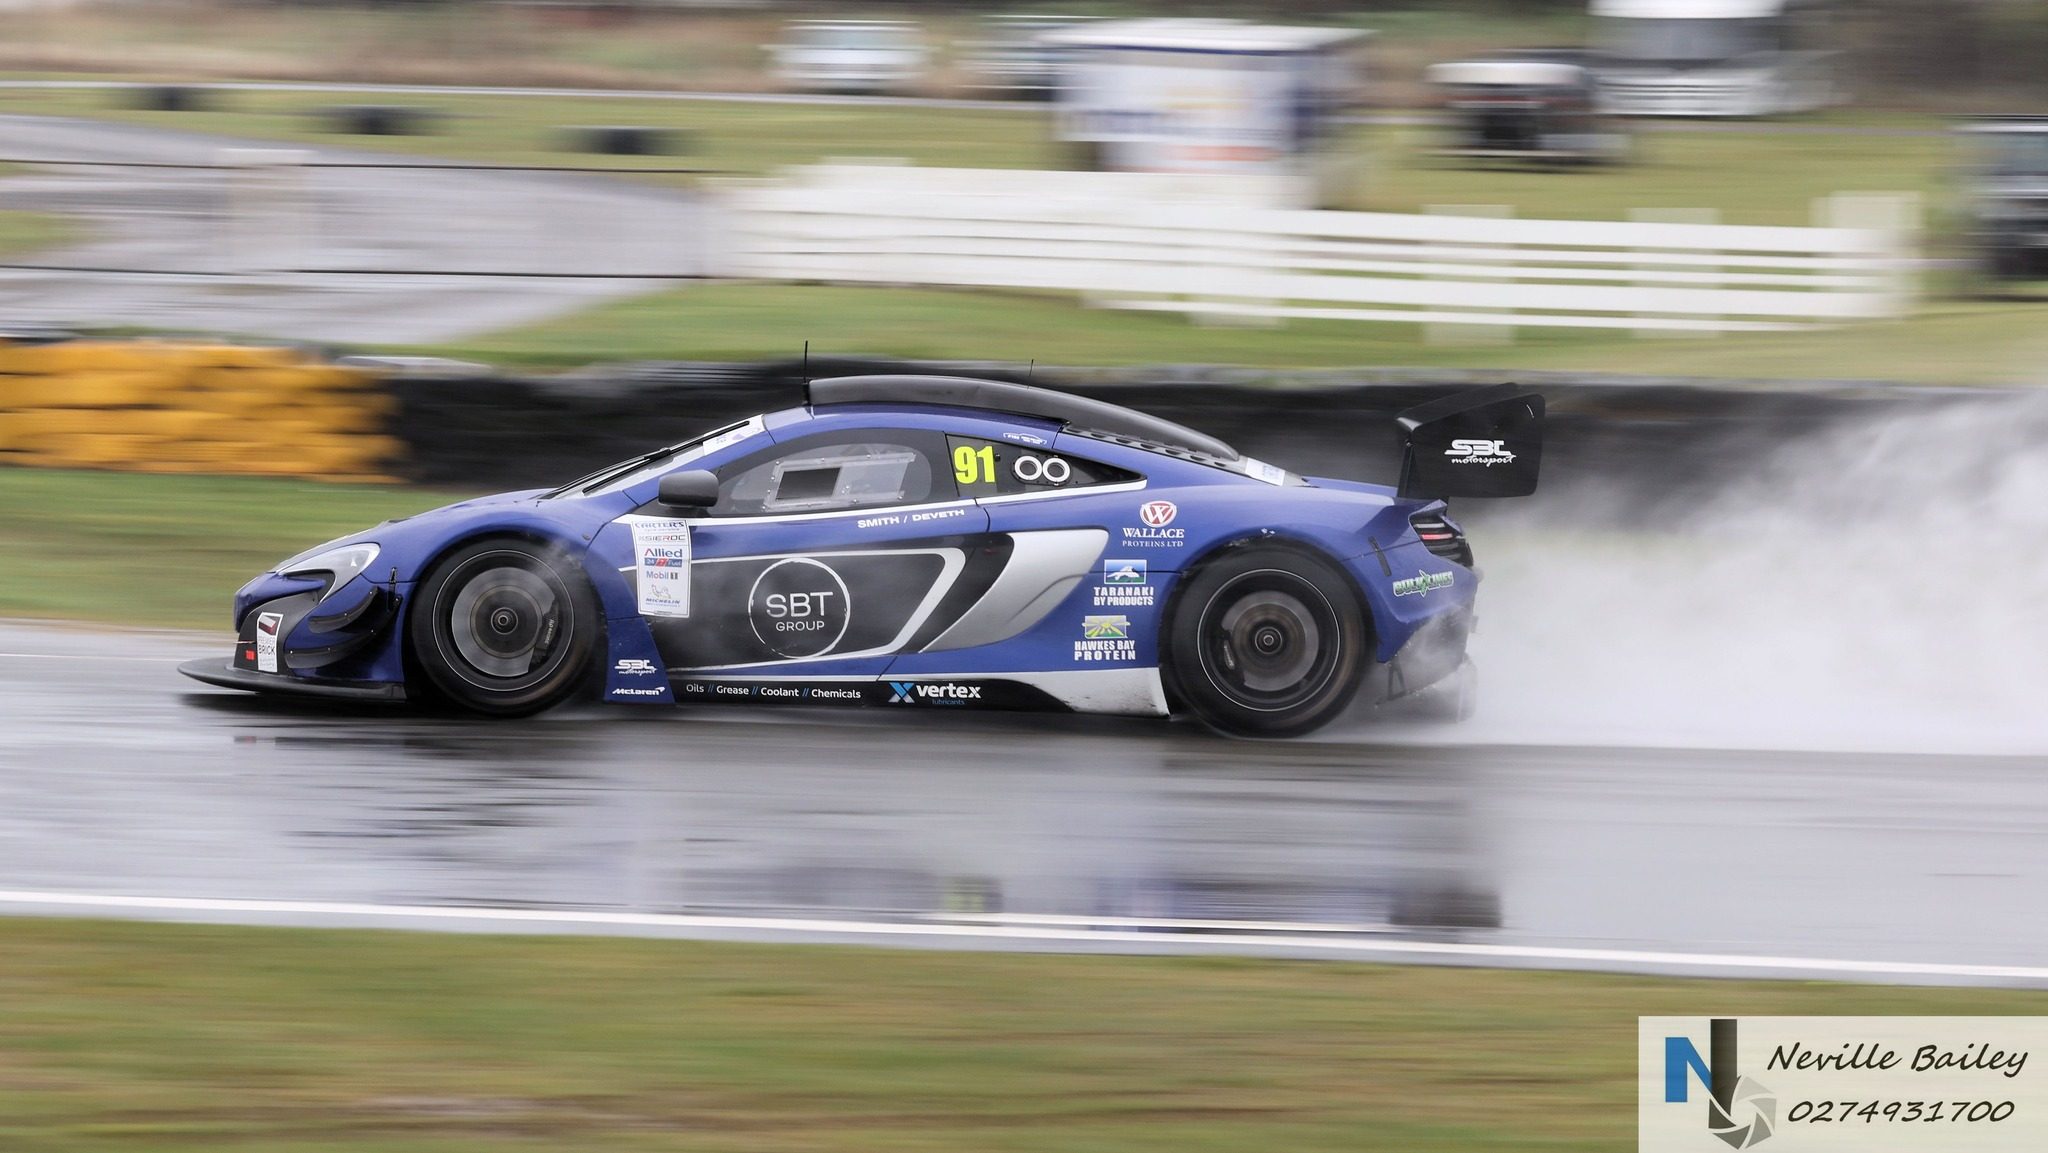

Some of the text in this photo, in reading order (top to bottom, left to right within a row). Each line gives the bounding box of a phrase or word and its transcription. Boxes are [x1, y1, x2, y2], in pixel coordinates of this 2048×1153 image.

[954, 445, 996, 484] 91
[1451, 455, 1517, 468] motorsport
[857, 516, 900, 529] SMITH
[911, 509, 966, 522] DEVETH
[1122, 527, 1185, 539] WALLACE
[644, 548, 683, 558] Allied
[646, 571, 669, 580] Mobil
[1093, 586, 1154, 597] TARANAKI
[766, 591, 834, 618] SBT
[1093, 596, 1154, 606] BY PRODUCTS
[775, 620, 825, 632] GROUP
[1074, 640, 1136, 651] HAWKES BAY
[1074, 650, 1136, 661] PROTEIN
[686, 684, 704, 693] Oils
[716, 685, 749, 695] Grease
[760, 687, 799, 697] Coolant
[811, 688, 861, 699] Chemicals
[916, 683, 982, 699] vertex
